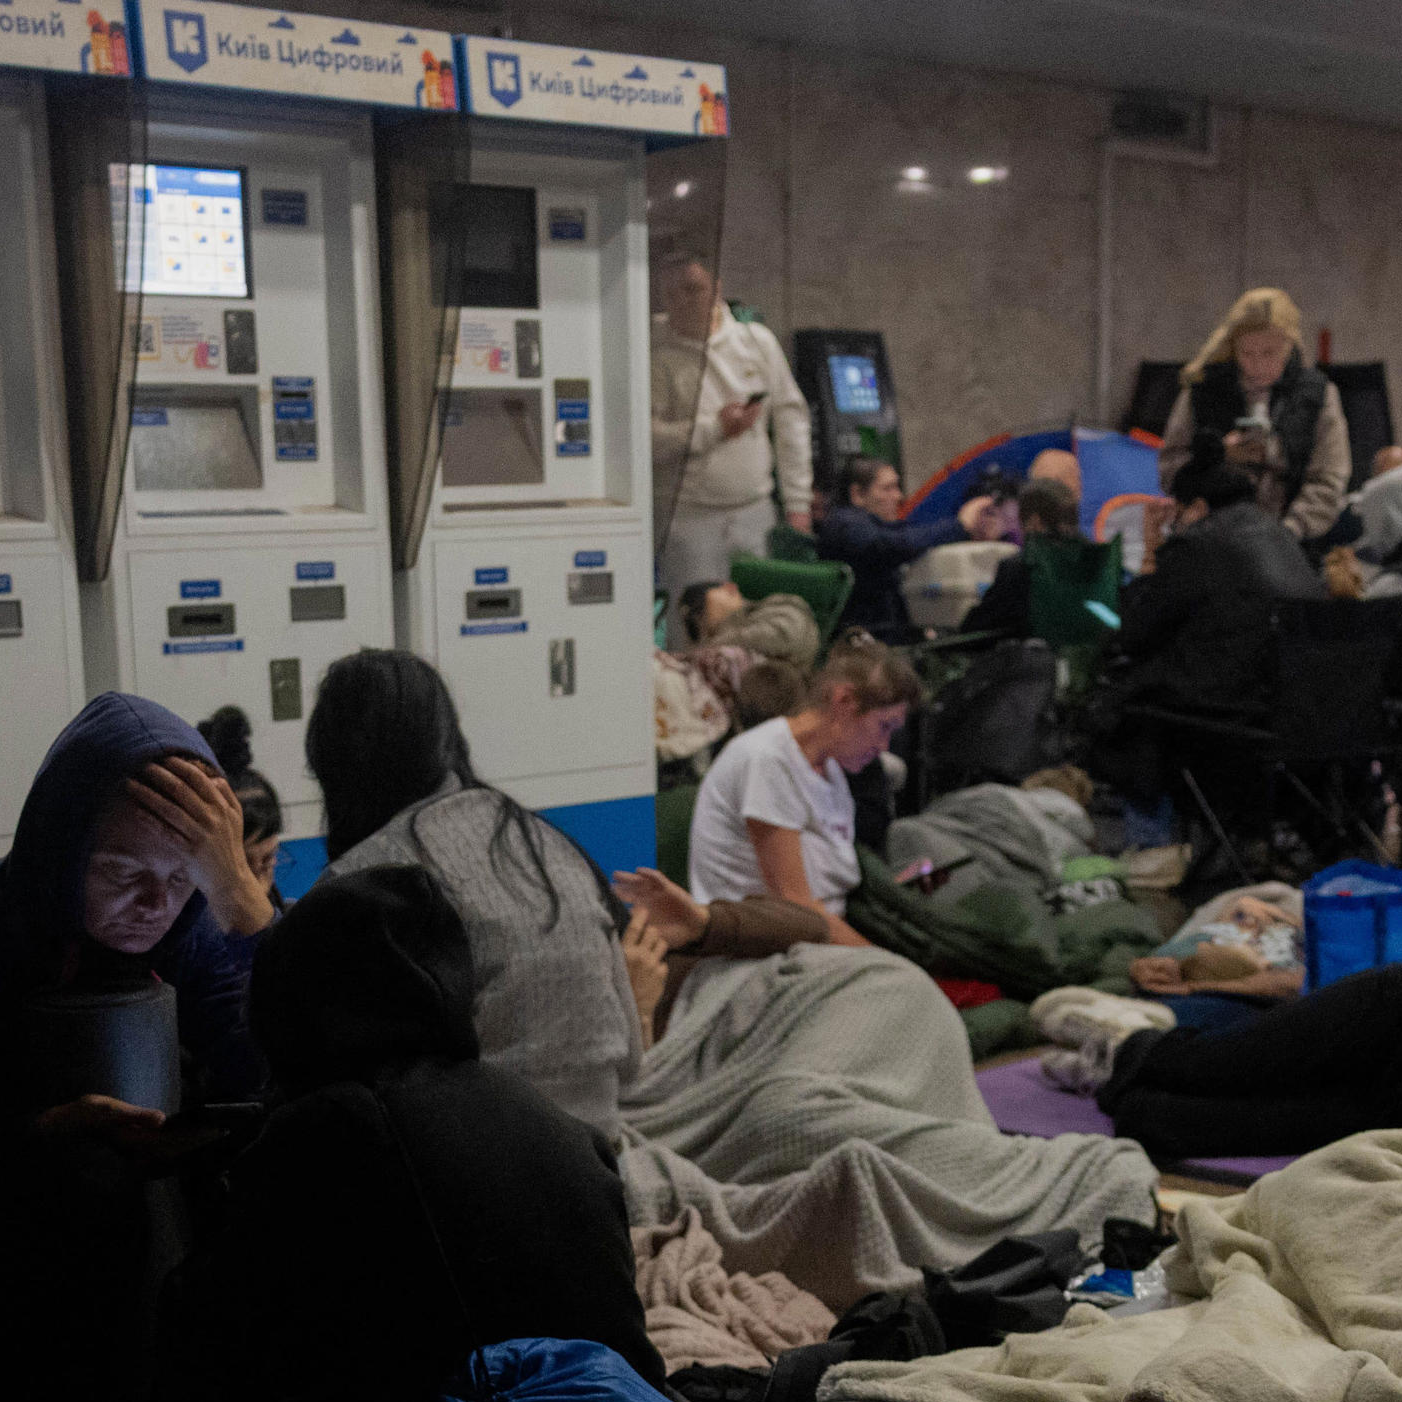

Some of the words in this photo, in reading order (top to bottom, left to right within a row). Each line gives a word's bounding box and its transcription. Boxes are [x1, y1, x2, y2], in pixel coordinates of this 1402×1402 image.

[216, 31, 271, 61] Київ
[277, 39, 404, 75] Цифровий
[528, 70, 574, 96] Київ
[579, 75, 694, 108] Цифровий
